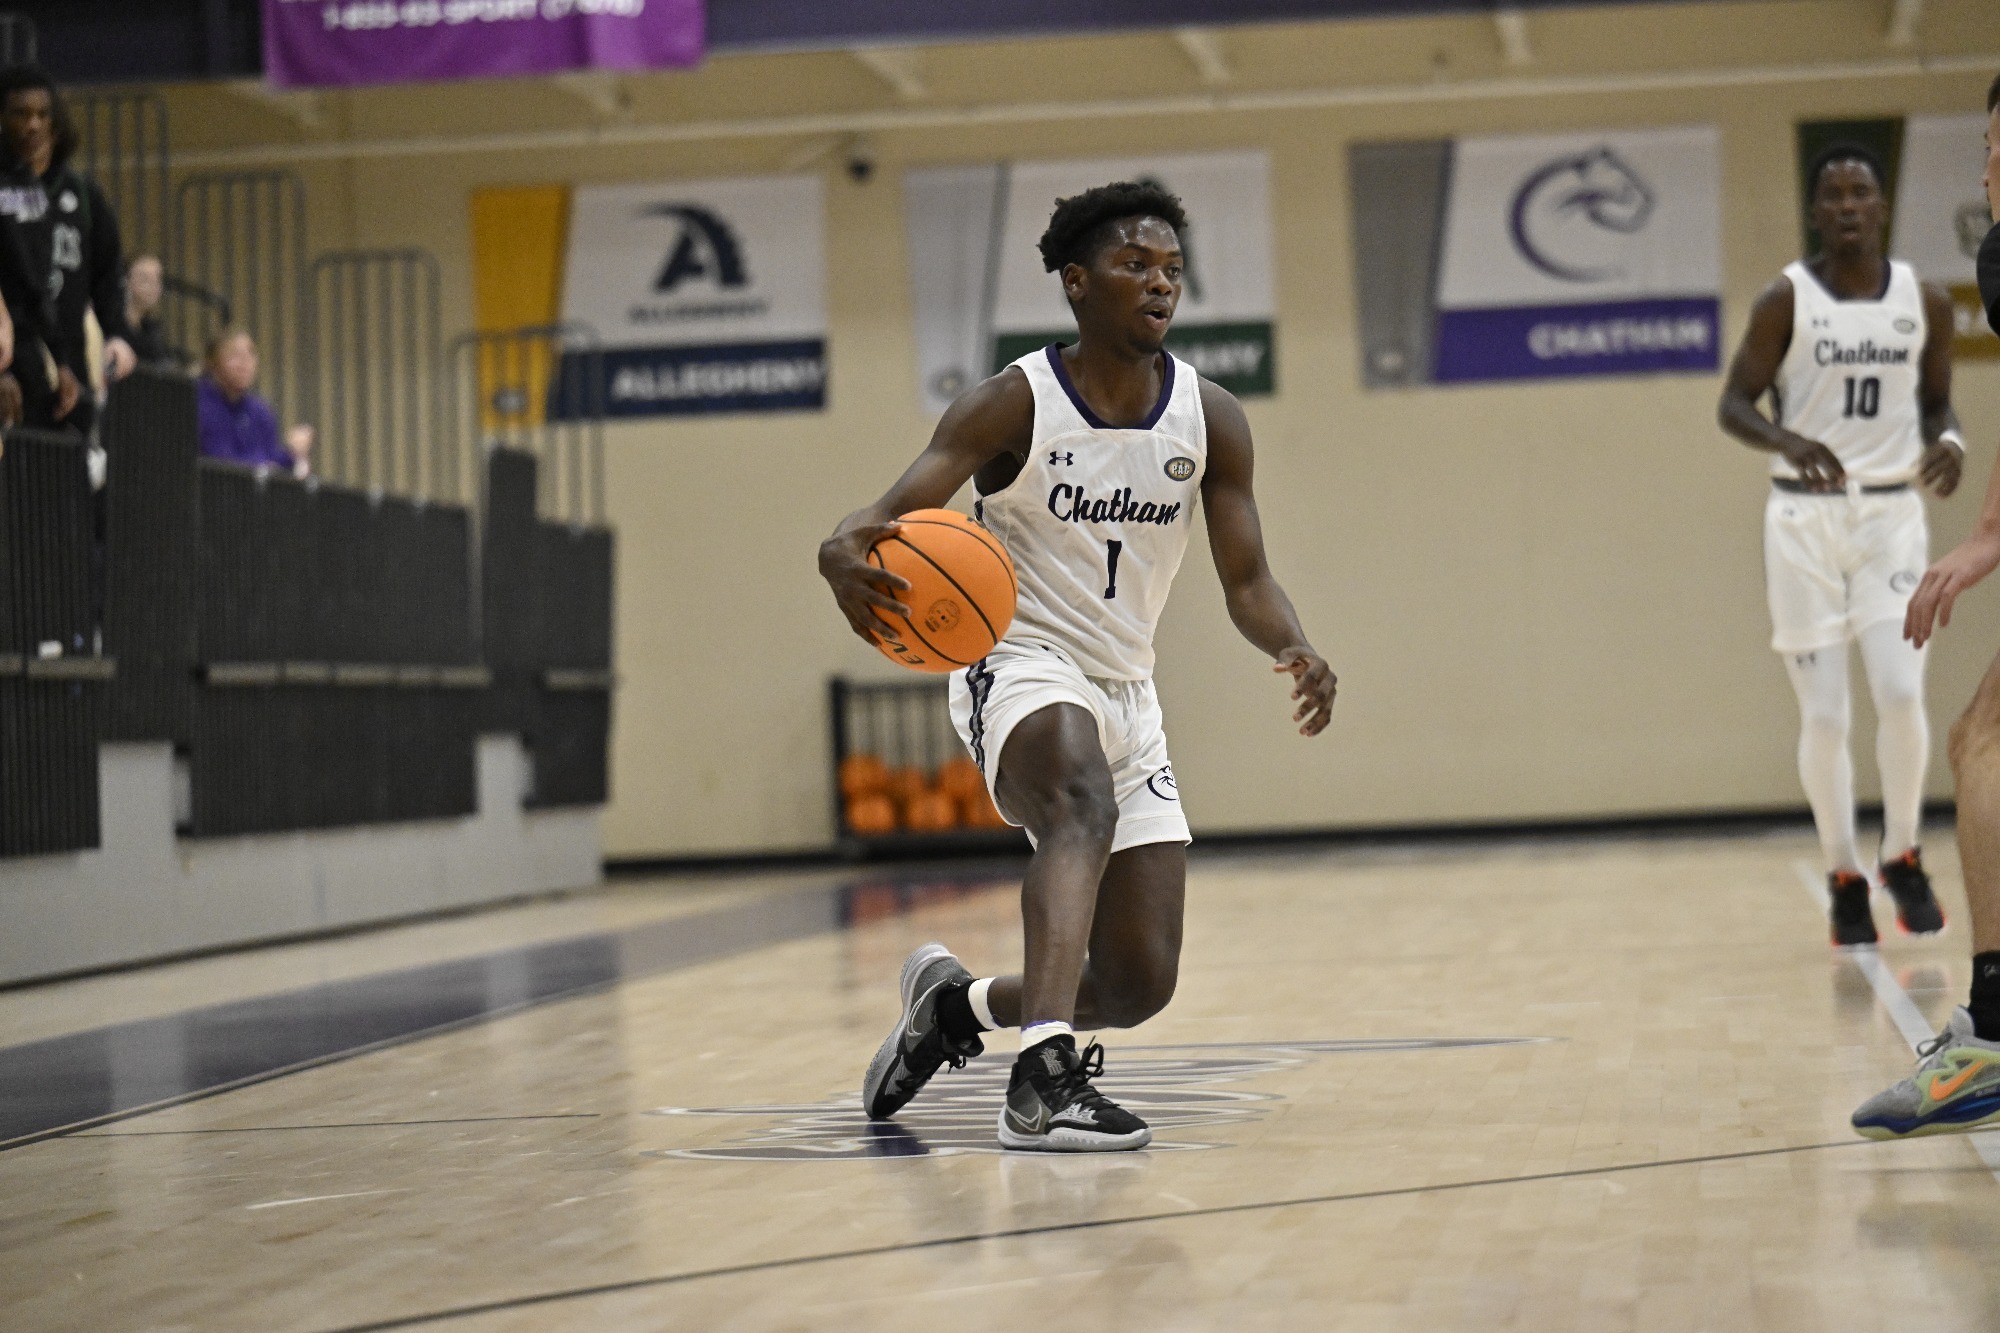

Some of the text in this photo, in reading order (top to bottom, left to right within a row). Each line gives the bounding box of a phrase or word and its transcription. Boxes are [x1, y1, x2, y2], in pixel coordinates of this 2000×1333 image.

[1529, 319, 1707, 359] CHATHAM
[1815, 339, 1908, 366] Chatham
[612, 359, 824, 399] ALLEGHENY
[1843, 377, 1880, 419] 10
[1172, 464, 1190, 476] PAC
[1048, 483, 1180, 525] Chatham
[1104, 539, 1122, 599] 1
